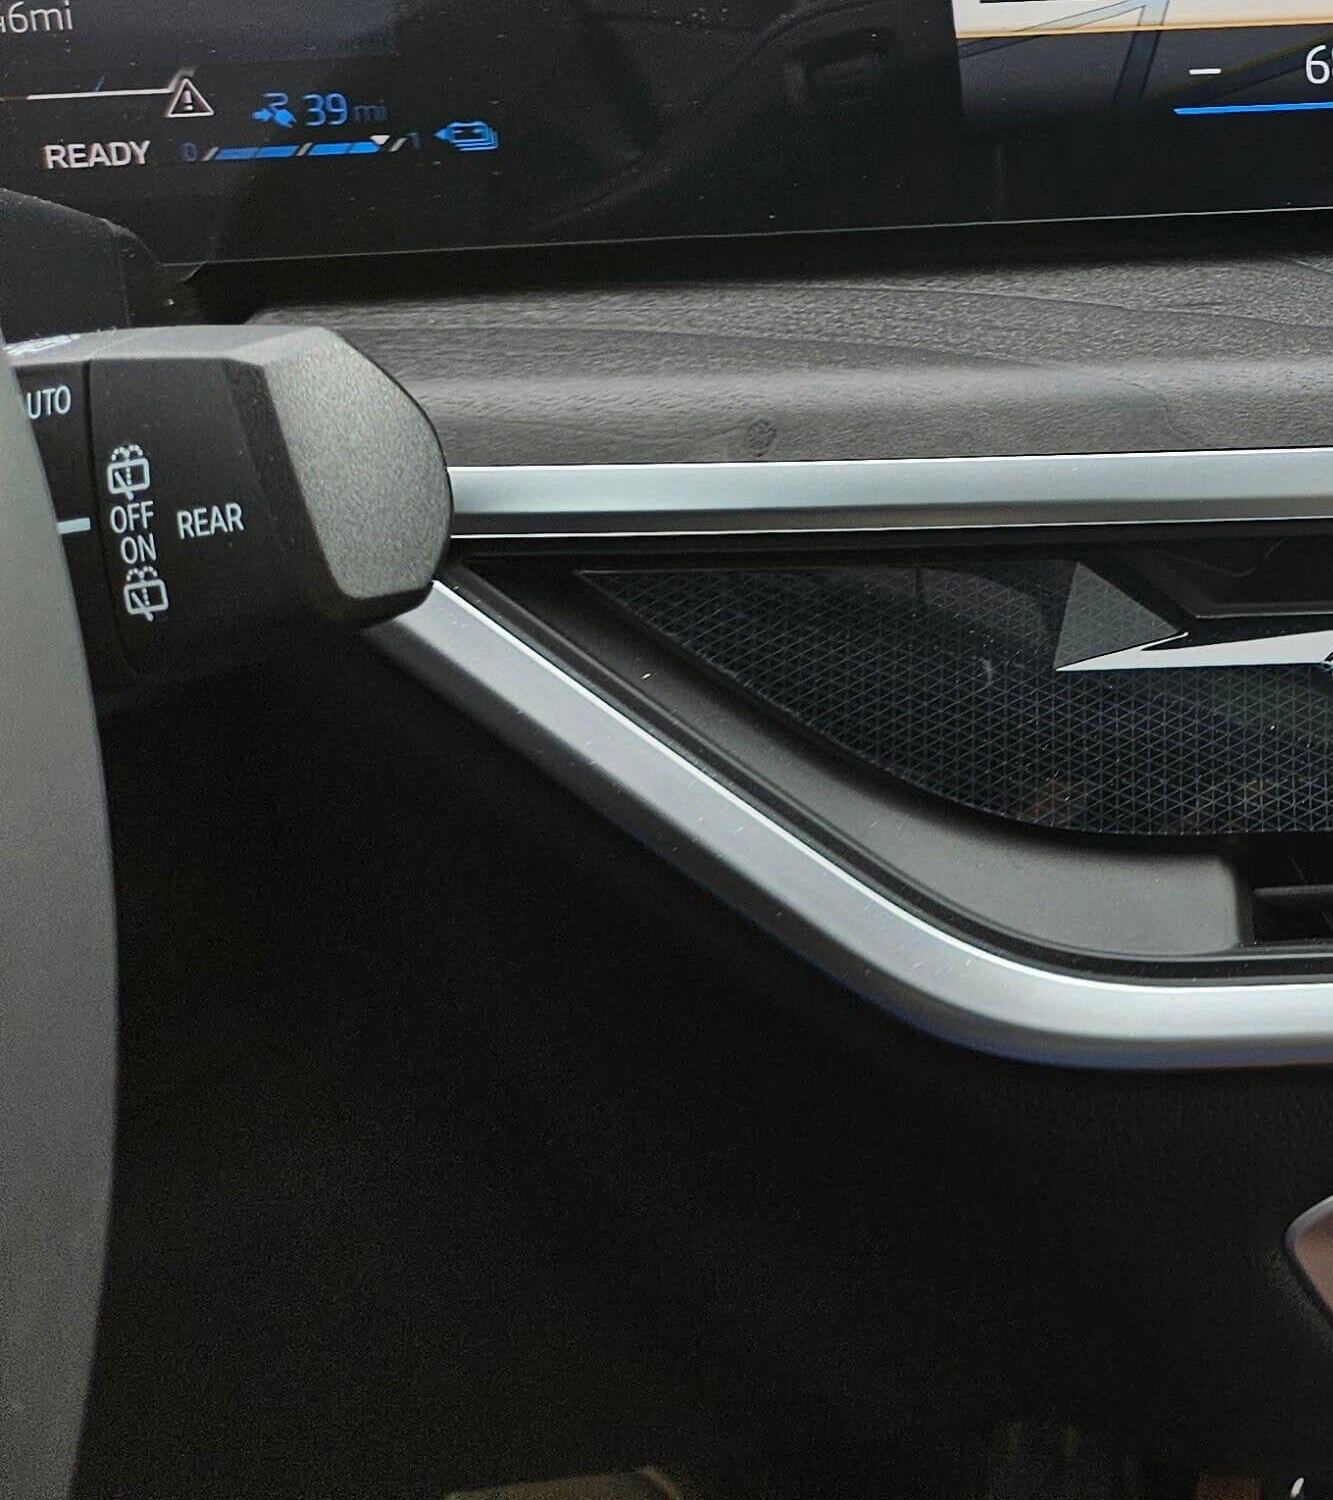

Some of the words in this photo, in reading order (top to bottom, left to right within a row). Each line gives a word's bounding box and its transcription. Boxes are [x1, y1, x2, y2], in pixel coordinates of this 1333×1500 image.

[305, 92, 348, 127] 39
[353, 98, 387, 122] mi
[44, 140, 151, 170] READY
[110, 500, 154, 534] OFF
[176, 502, 245, 540] REAR
[120, 534, 156, 565] ON
